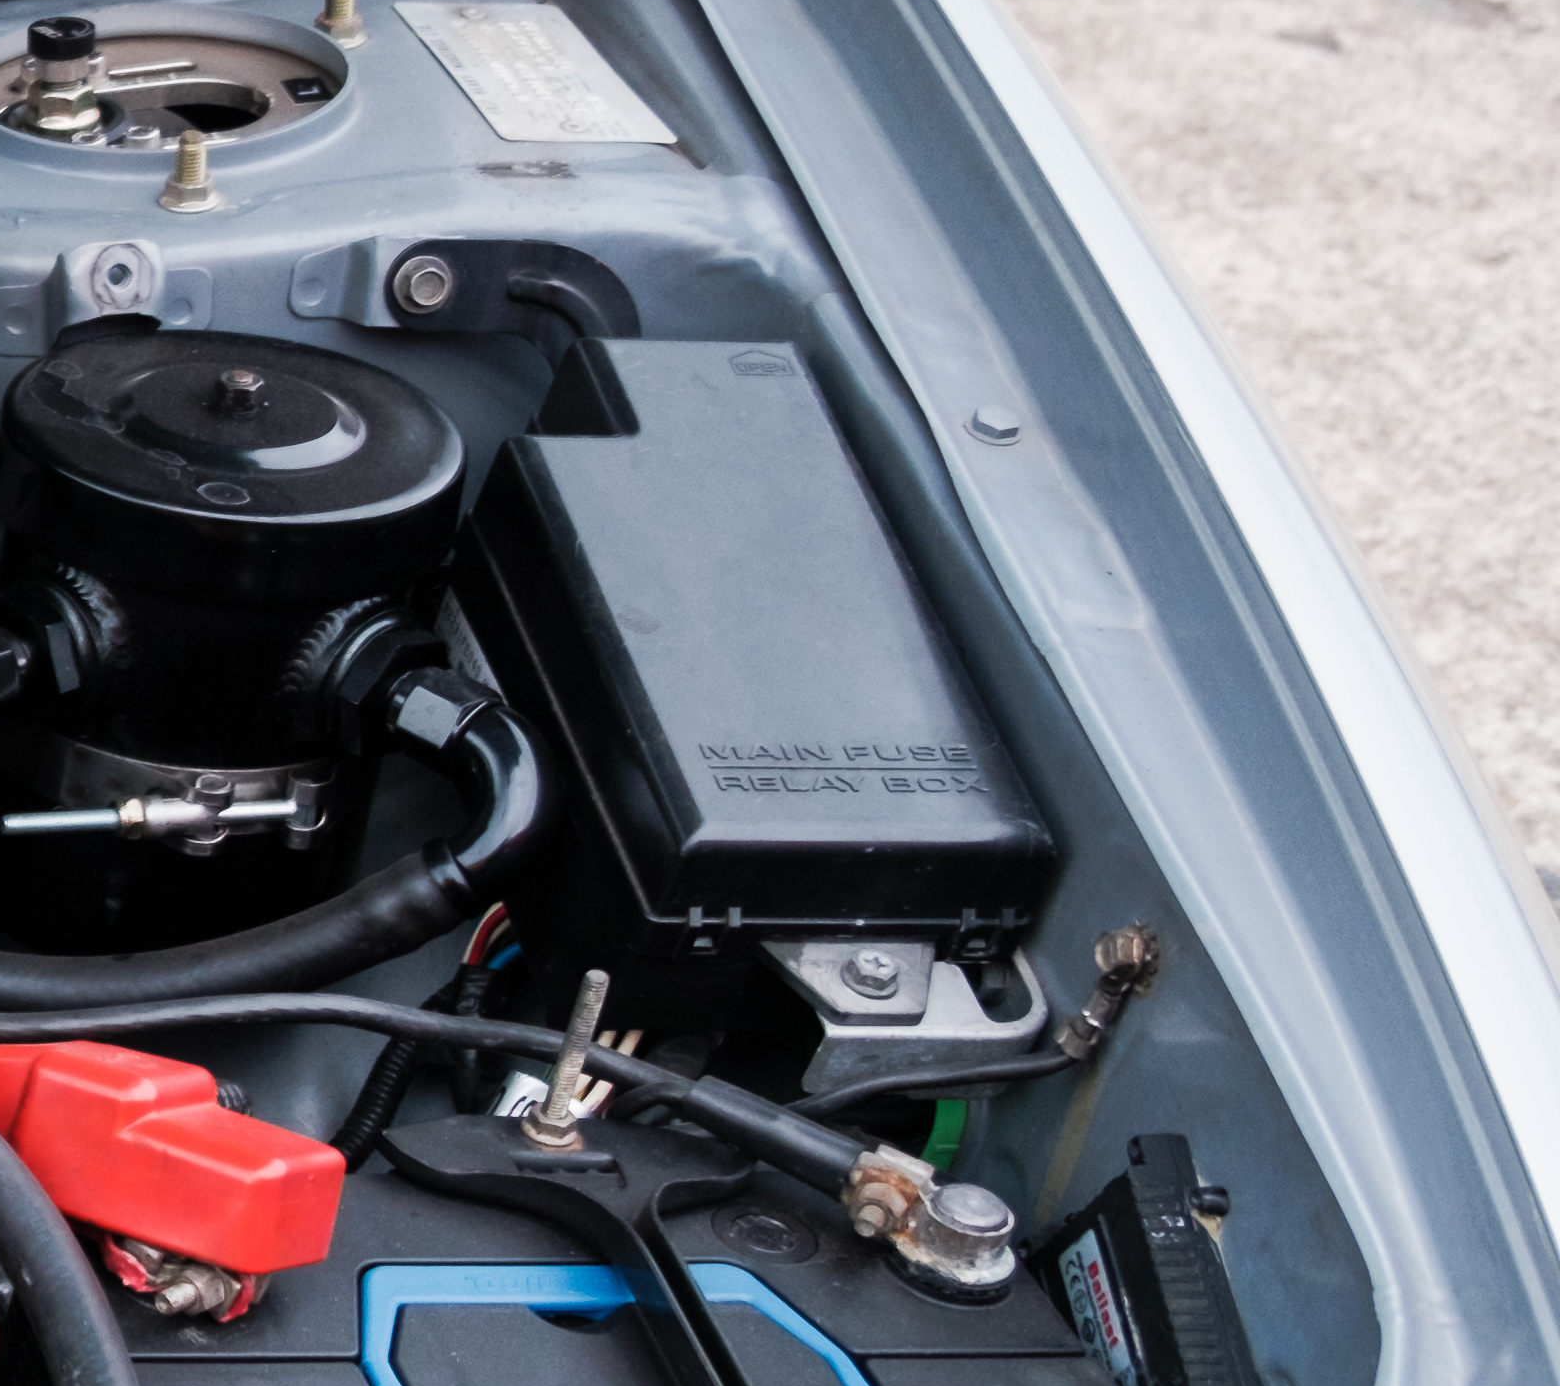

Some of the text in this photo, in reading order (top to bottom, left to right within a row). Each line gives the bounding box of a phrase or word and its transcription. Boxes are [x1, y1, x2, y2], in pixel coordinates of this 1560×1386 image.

[698, 744, 972, 762] MAIN FUSE
[713, 775, 989, 794] RELAY BOX
[1087, 1259, 1119, 1350] Ballast
